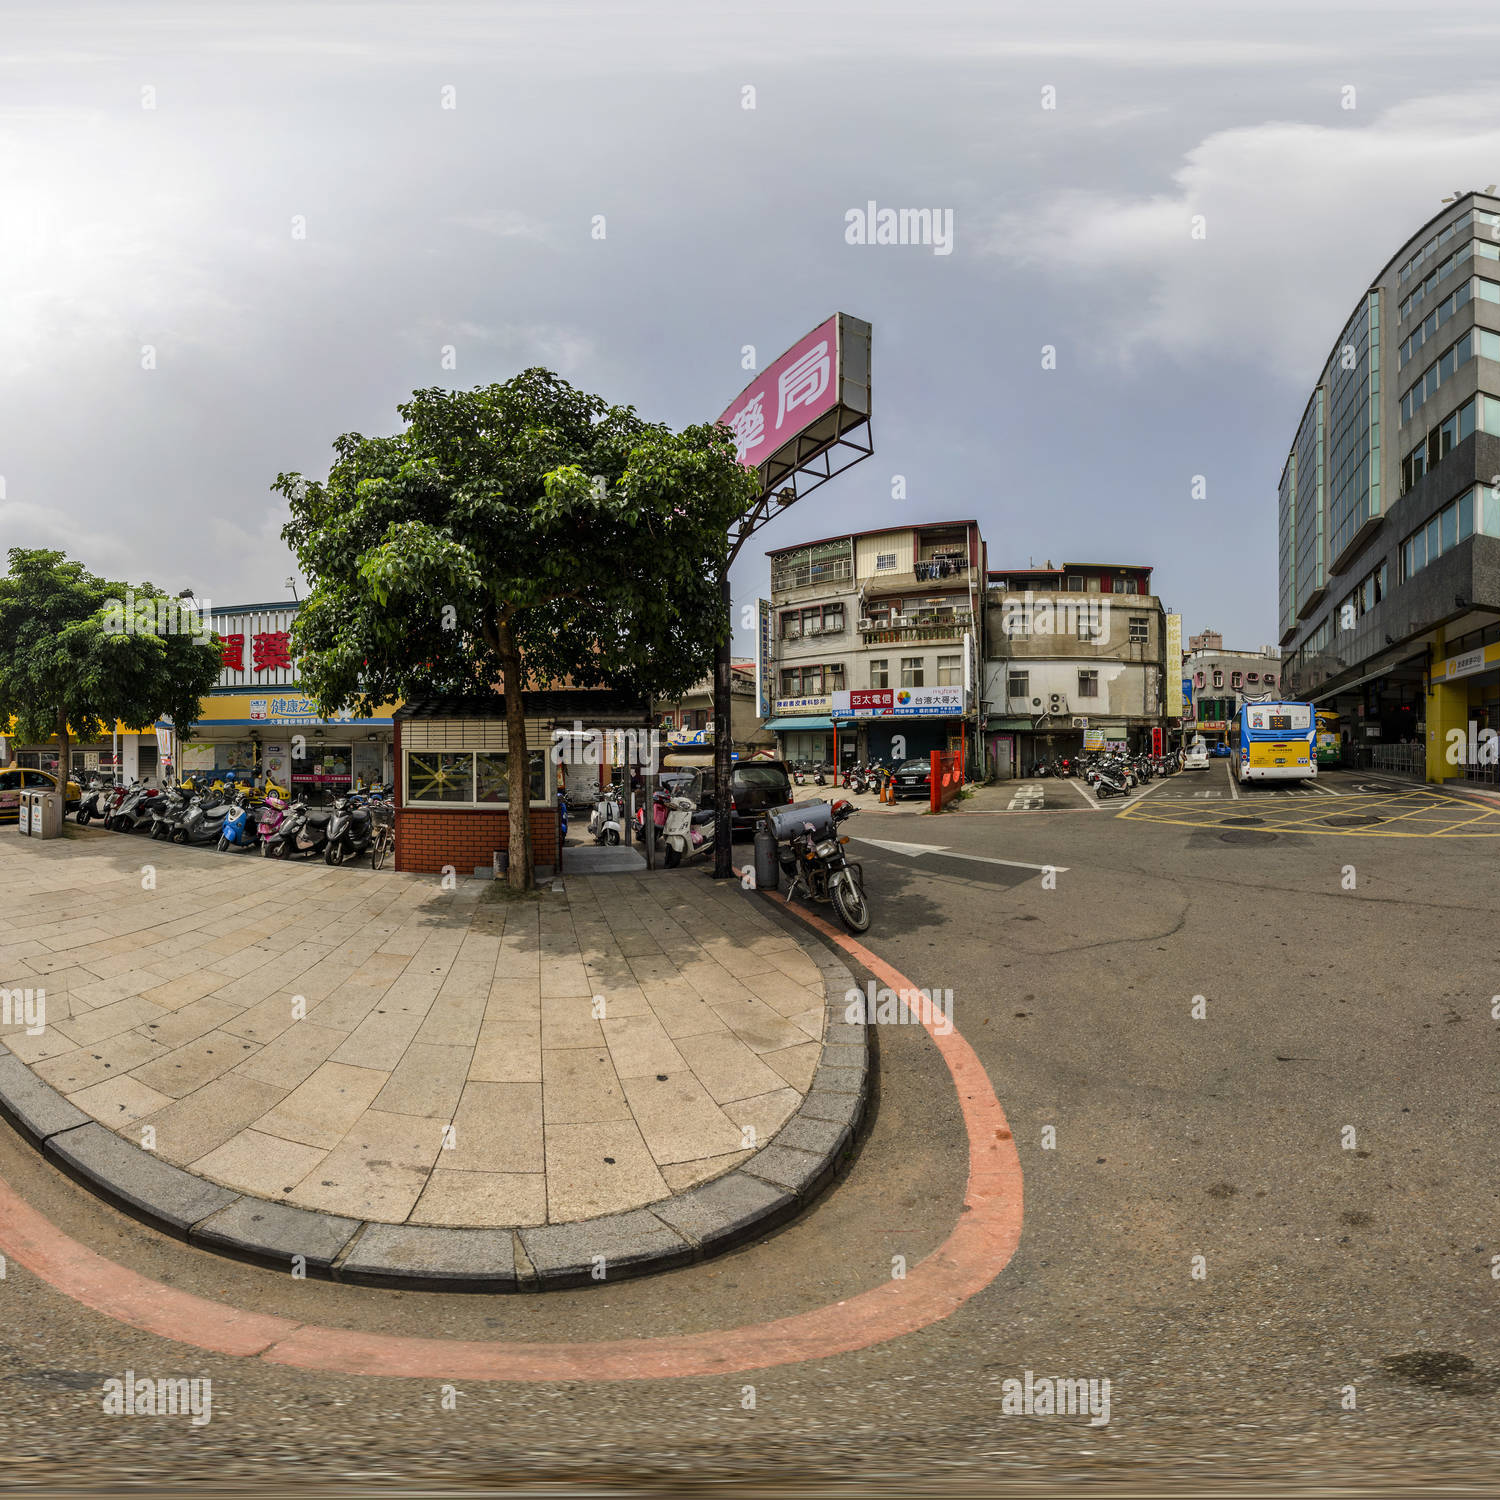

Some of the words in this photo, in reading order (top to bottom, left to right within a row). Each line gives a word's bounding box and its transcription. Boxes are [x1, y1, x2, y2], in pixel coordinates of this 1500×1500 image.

[729, 340, 830, 461] 藥局
[852, 694, 892, 705] 亞太電信
